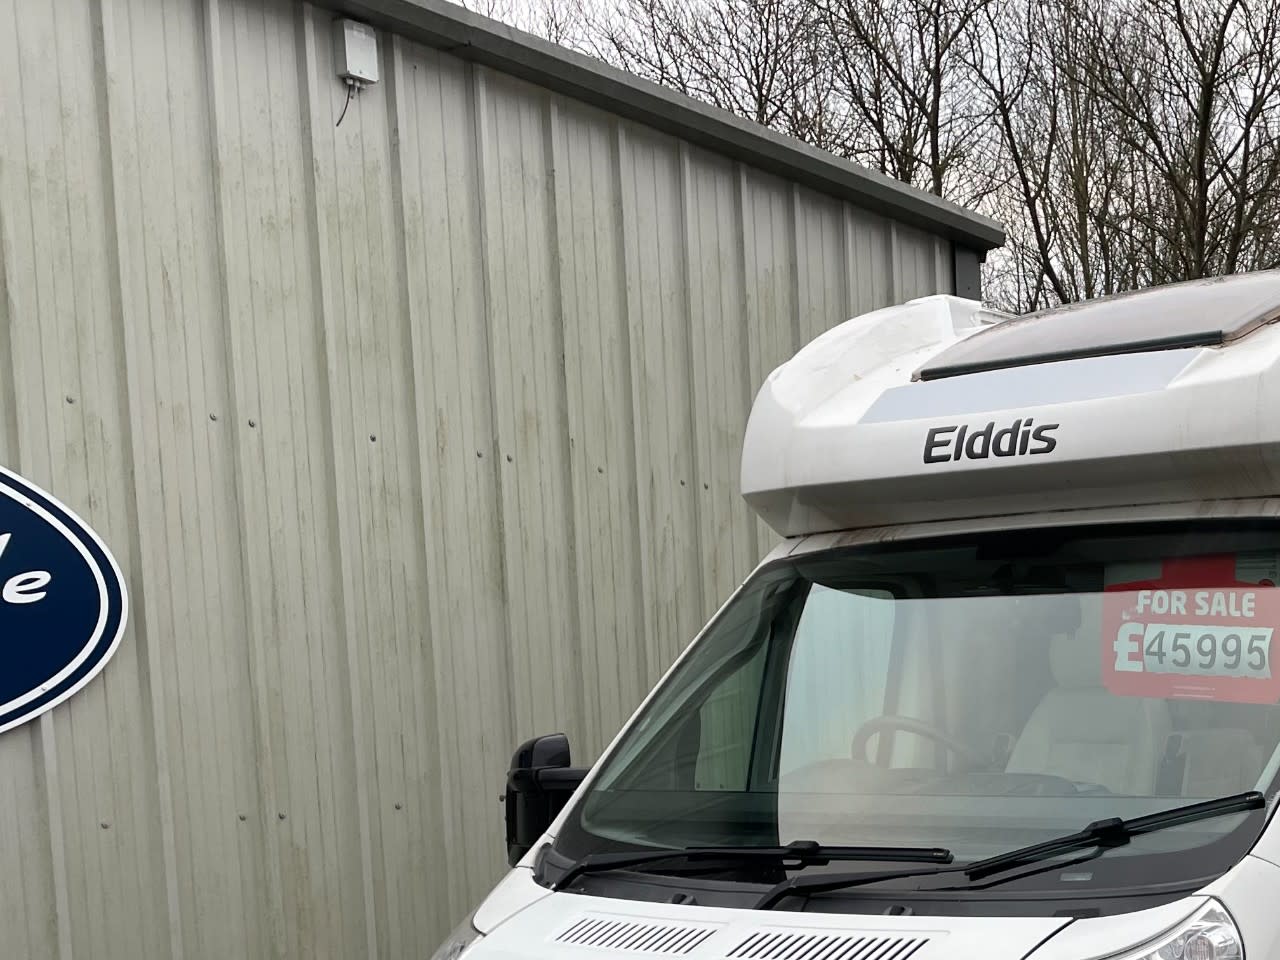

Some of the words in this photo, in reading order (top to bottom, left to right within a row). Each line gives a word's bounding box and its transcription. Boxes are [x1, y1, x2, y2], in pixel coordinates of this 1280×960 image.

[924, 418, 1060, 464] Elddis
[1136, 590, 1188, 616] FOR
[1195, 591, 1257, 618] SALE
[1113, 622, 1267, 672] £45995
